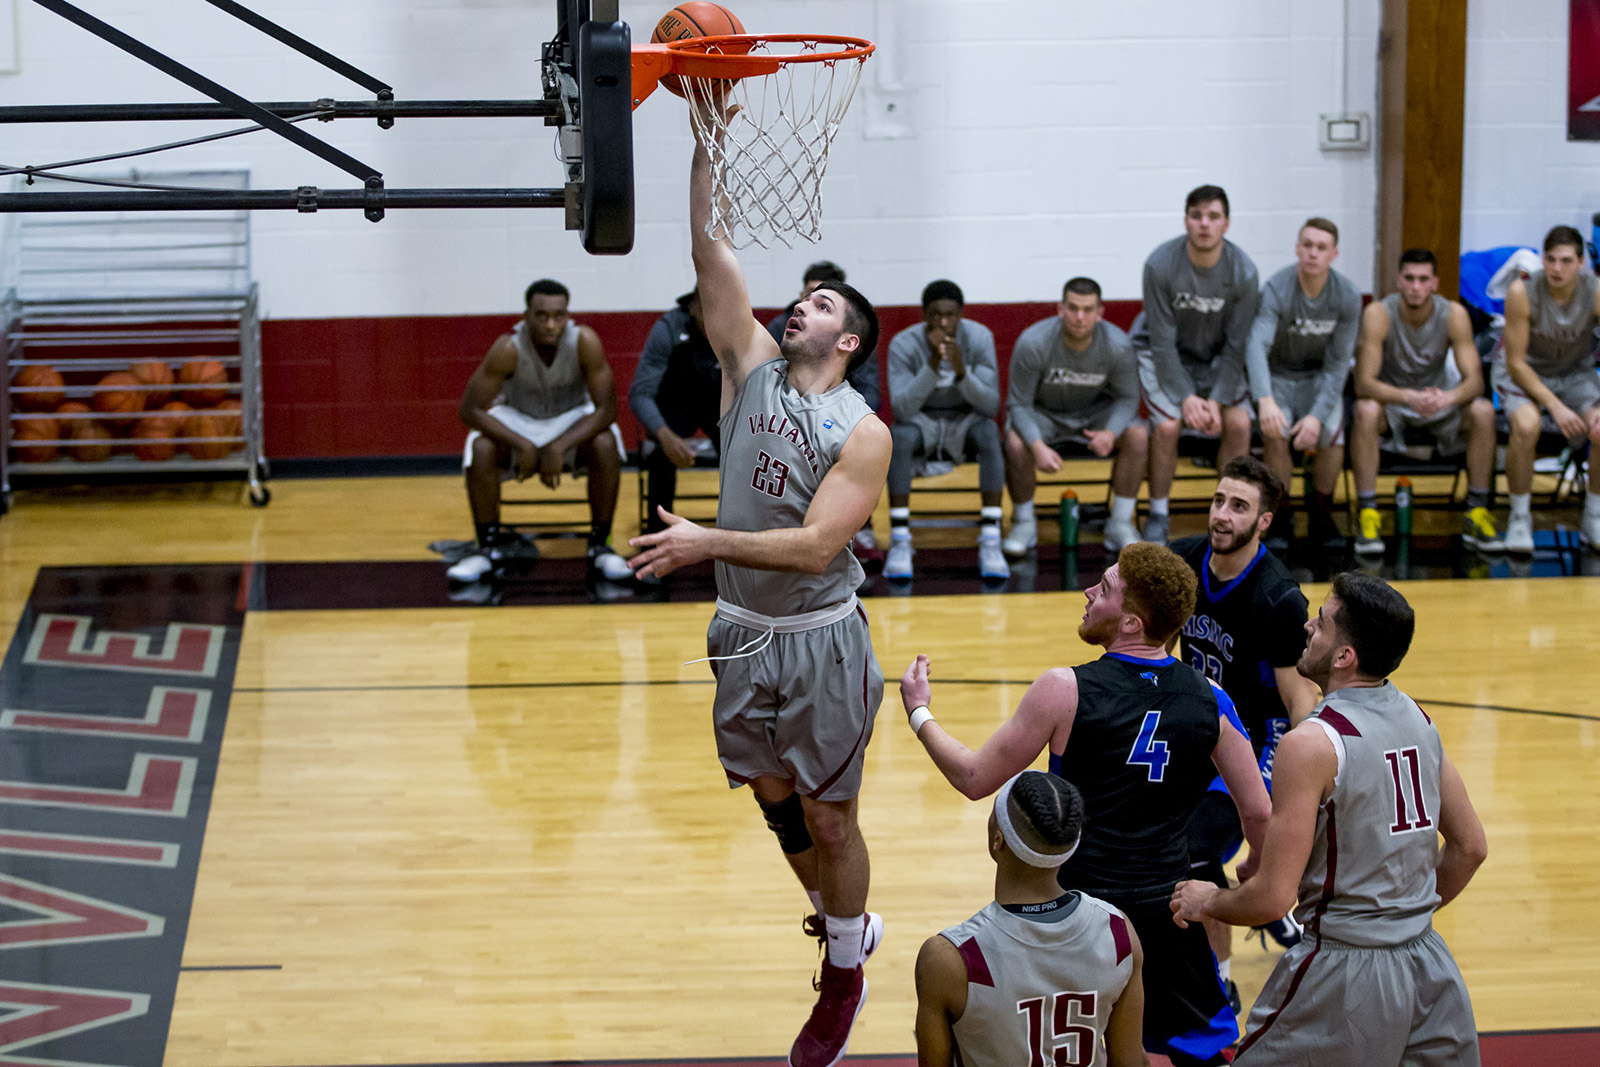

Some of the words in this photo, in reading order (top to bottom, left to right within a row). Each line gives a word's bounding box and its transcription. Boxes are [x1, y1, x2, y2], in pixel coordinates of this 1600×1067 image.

[660, 15, 682, 38] THE
[748, 412, 819, 475] VALIANT
[750, 449, 790, 499] 23
[1126, 710, 1170, 783] 4
[1383, 745, 1434, 836] 11
[1021, 904, 1041, 913] NIKE
[1041, 900, 1058, 911] PRO
[1016, 989, 1098, 1067] 15
